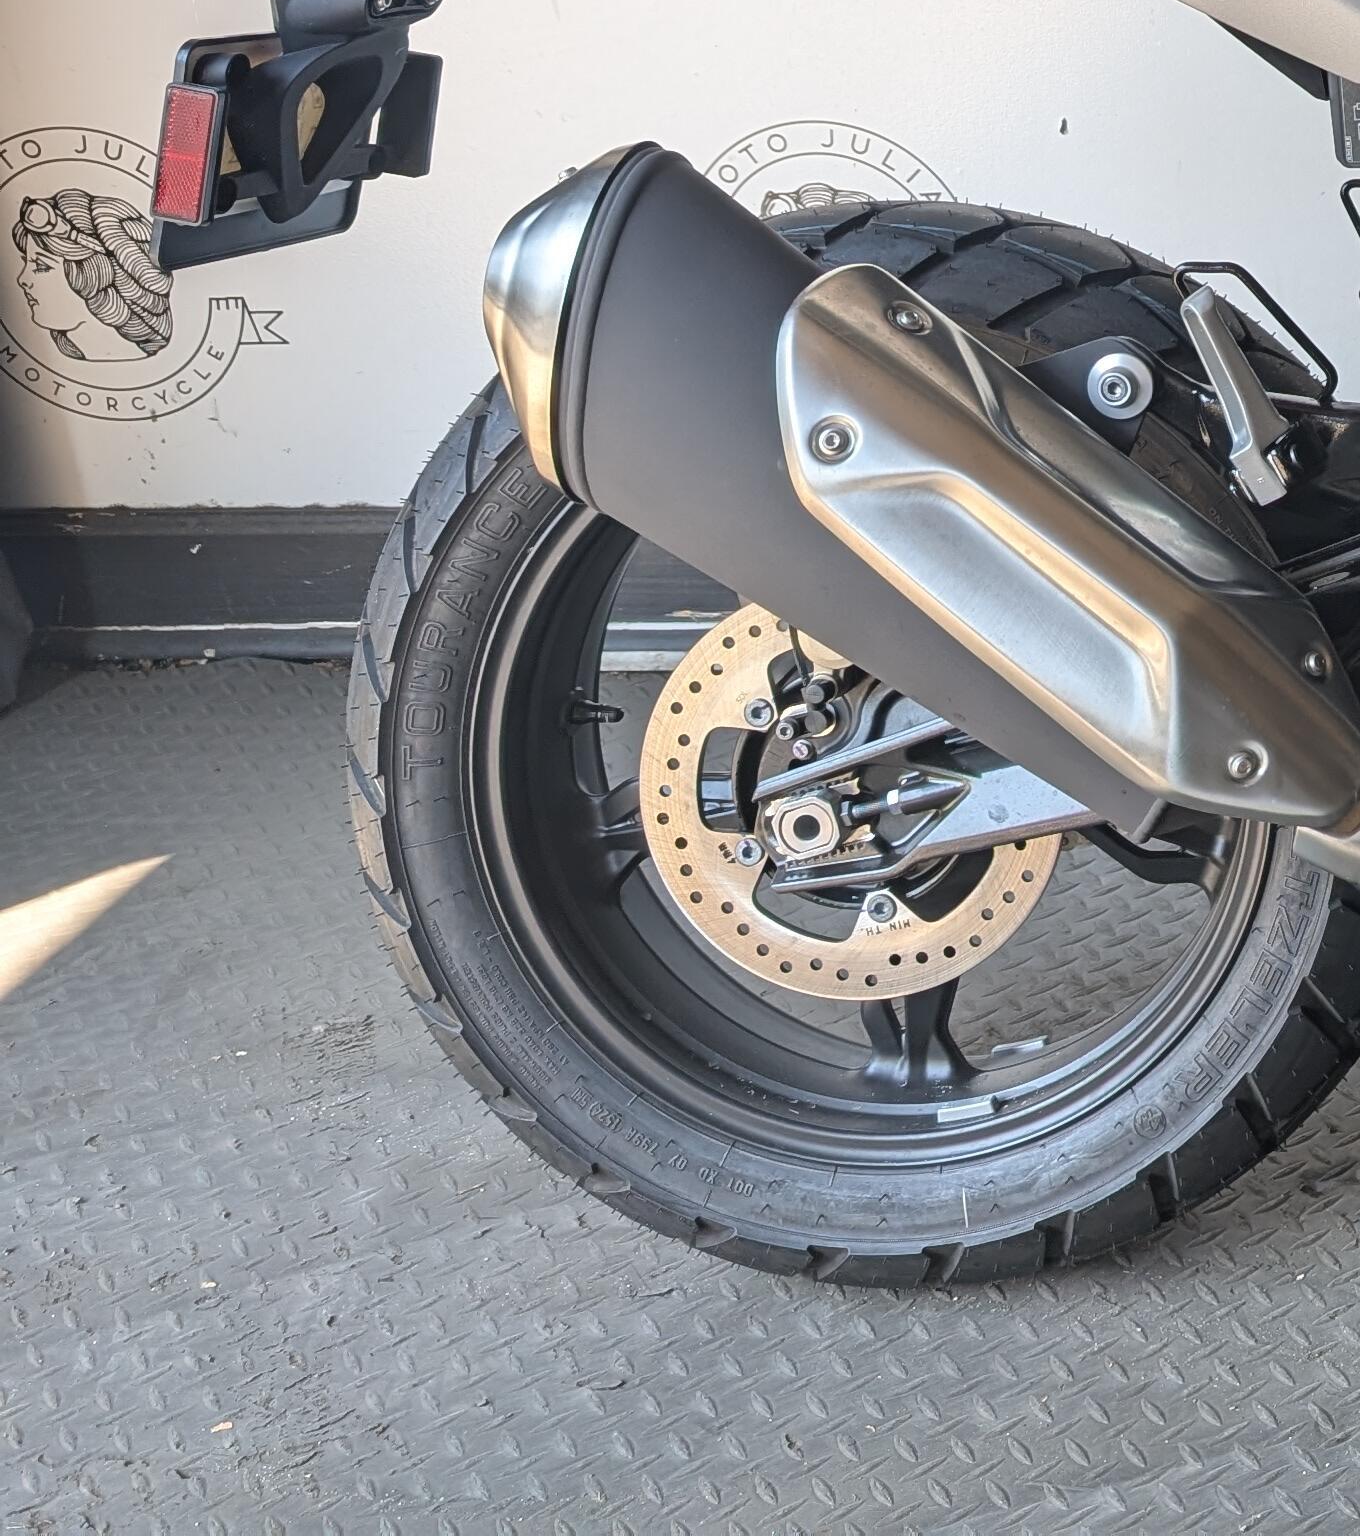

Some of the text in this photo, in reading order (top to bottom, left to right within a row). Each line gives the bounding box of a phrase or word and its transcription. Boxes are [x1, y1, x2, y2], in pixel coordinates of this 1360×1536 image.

[0, 135, 150, 177] TO JUL
[718, 134, 787, 183] OTO
[0, 345, 225, 412] MOTORCYCLE
[396, 458, 551, 783] TOURANCE
[1167, 864, 1321, 1110] TZELER
[696, 1164, 719, 1185] XD
[726, 1176, 755, 1197] DOT
